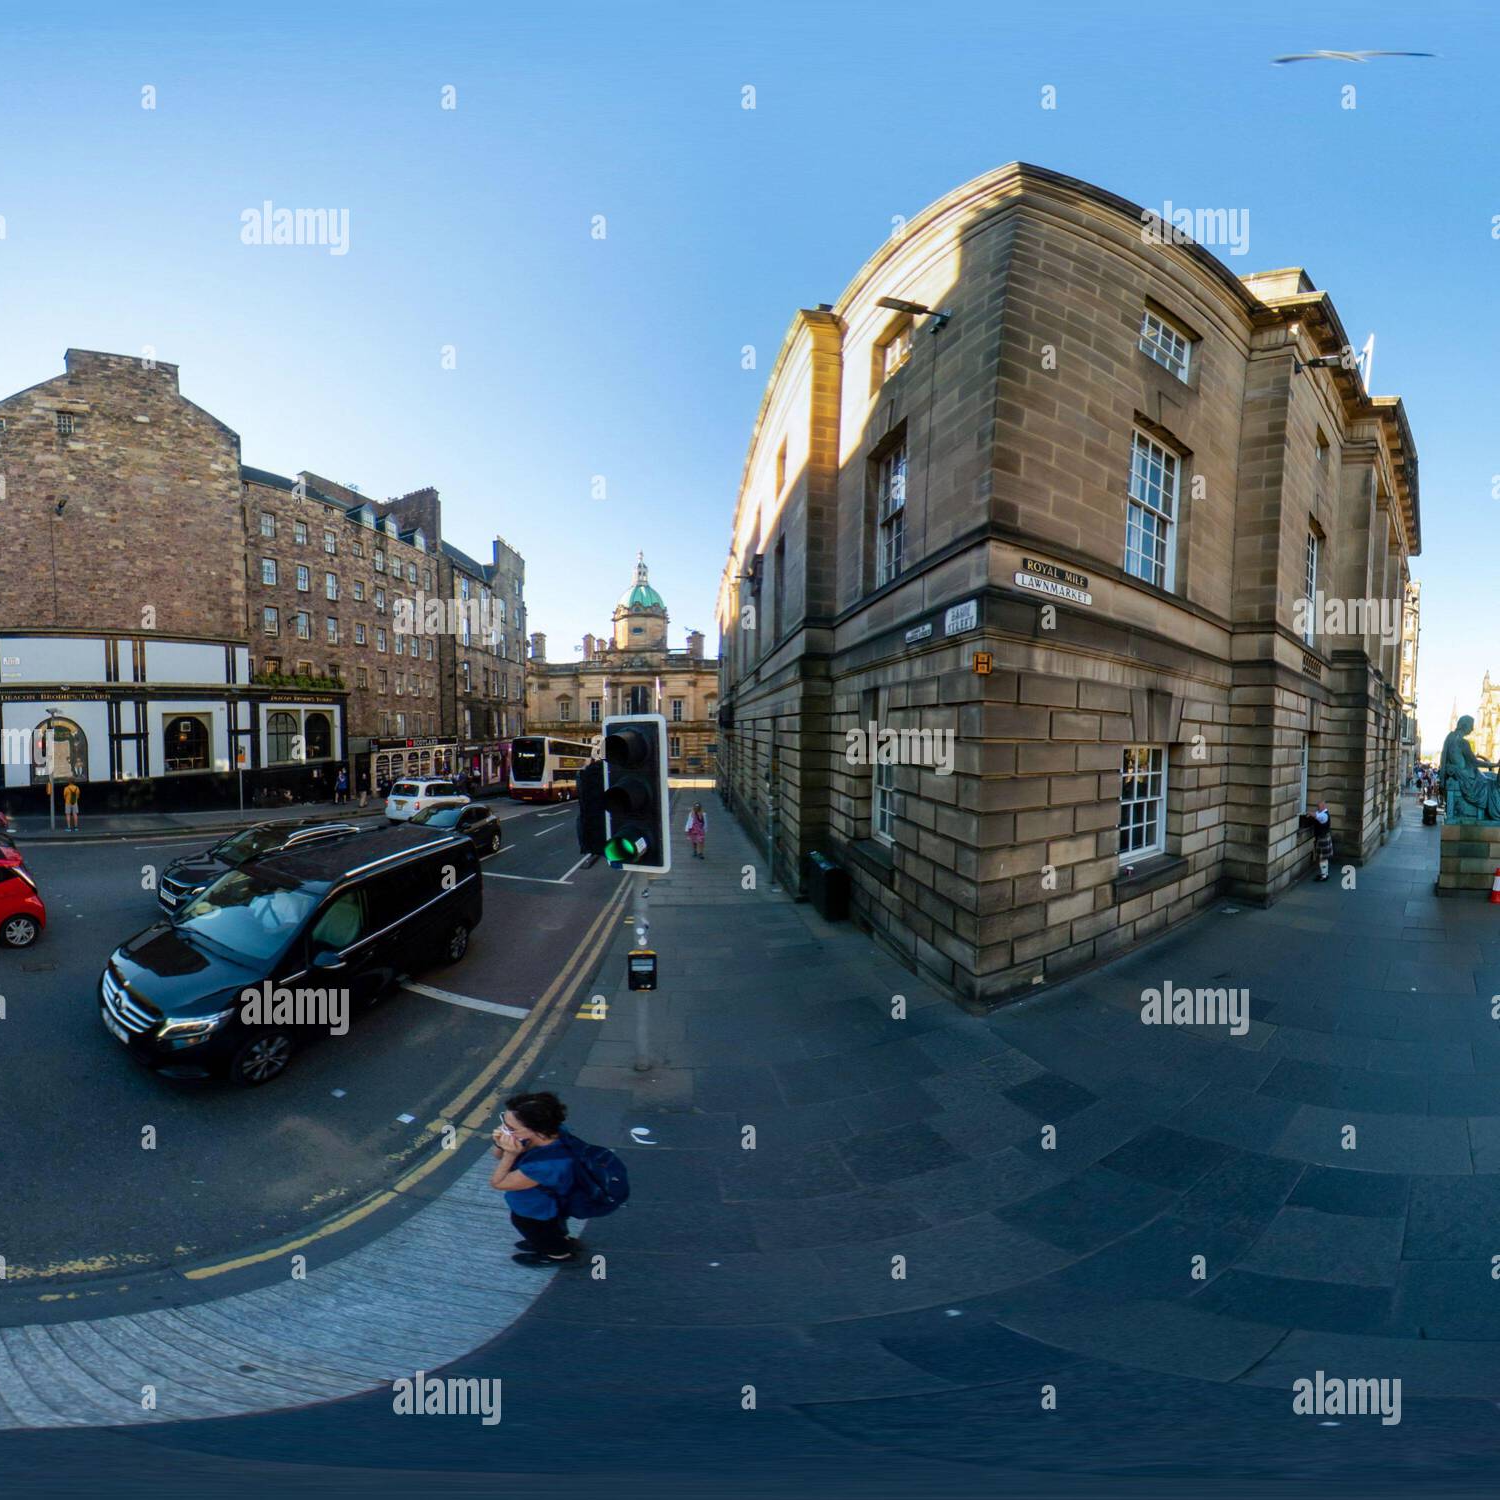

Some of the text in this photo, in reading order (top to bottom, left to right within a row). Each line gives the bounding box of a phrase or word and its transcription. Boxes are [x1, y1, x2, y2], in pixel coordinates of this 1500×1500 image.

[1027, 559, 1085, 587] ROYAL MILE
[1021, 574, 1088, 603] LAWNMARKET
